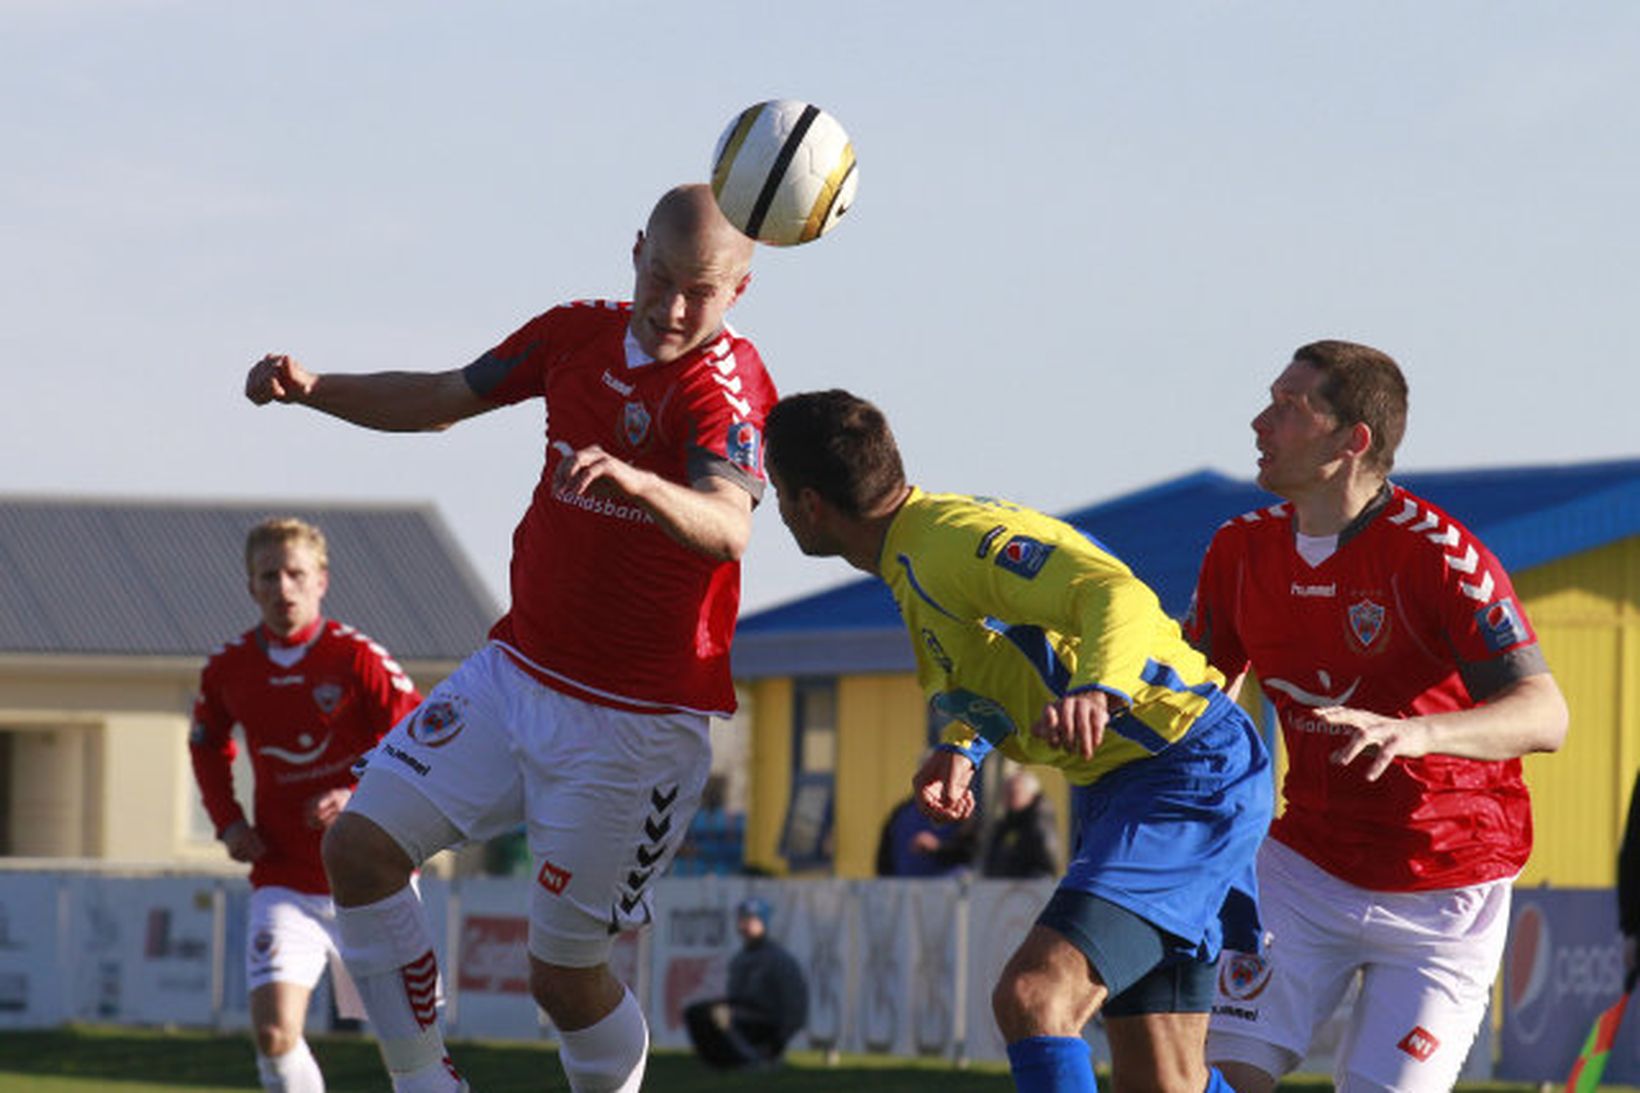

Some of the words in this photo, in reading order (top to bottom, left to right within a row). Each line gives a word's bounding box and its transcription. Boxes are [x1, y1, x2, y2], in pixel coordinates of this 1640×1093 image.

[1290, 581, 1337, 597] hummel
[384, 743, 431, 776] hummel
[1554, 946, 1622, 1008] peps
[1408, 1033, 1433, 1056] N1
